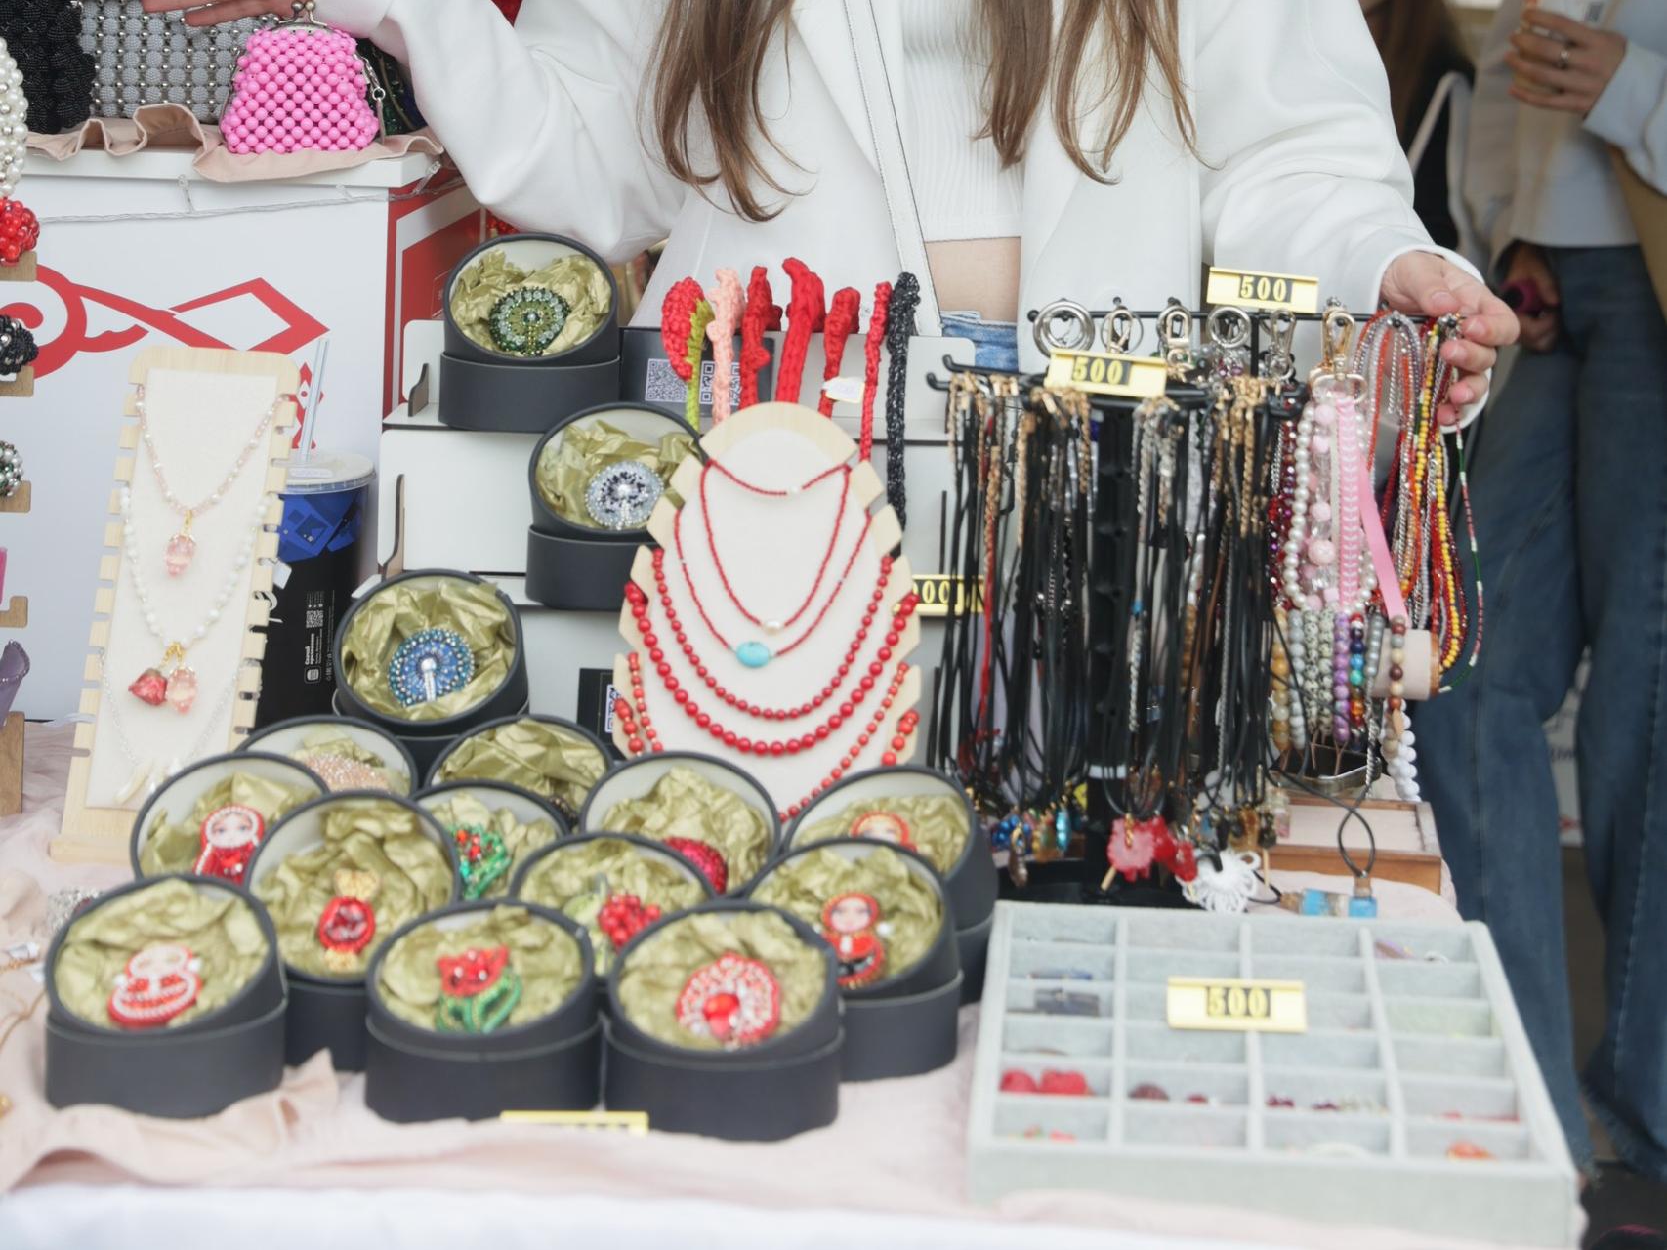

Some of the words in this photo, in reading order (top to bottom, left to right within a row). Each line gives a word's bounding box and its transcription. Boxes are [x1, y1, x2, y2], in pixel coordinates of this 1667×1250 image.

[1240, 275, 1288, 302] 500
[1072, 356, 1125, 386] 500
[1207, 986, 1269, 1019] 500
